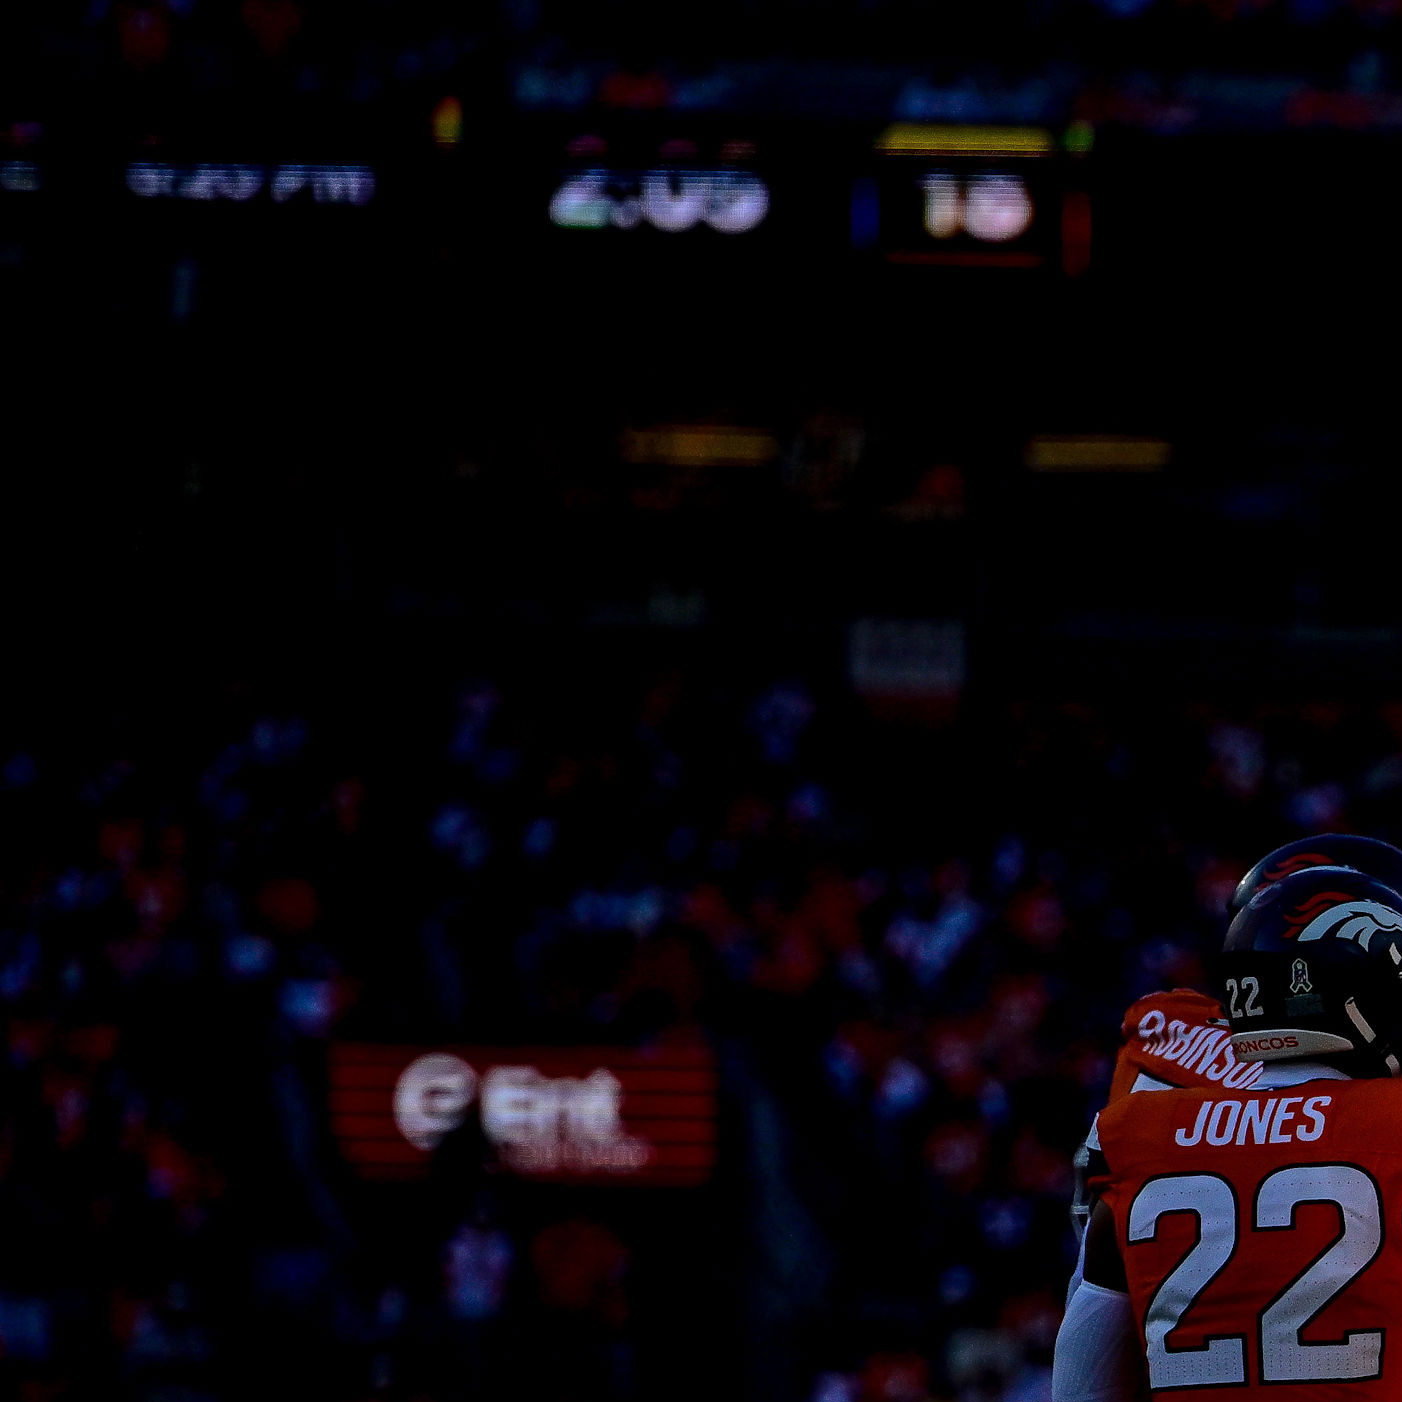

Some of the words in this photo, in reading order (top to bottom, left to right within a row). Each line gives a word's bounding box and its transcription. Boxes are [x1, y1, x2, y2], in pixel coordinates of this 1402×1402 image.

[1226, 976, 1264, 1019] 22
[1174, 1095, 1333, 1148] JONES
[1126, 1161, 1387, 1391] 22
